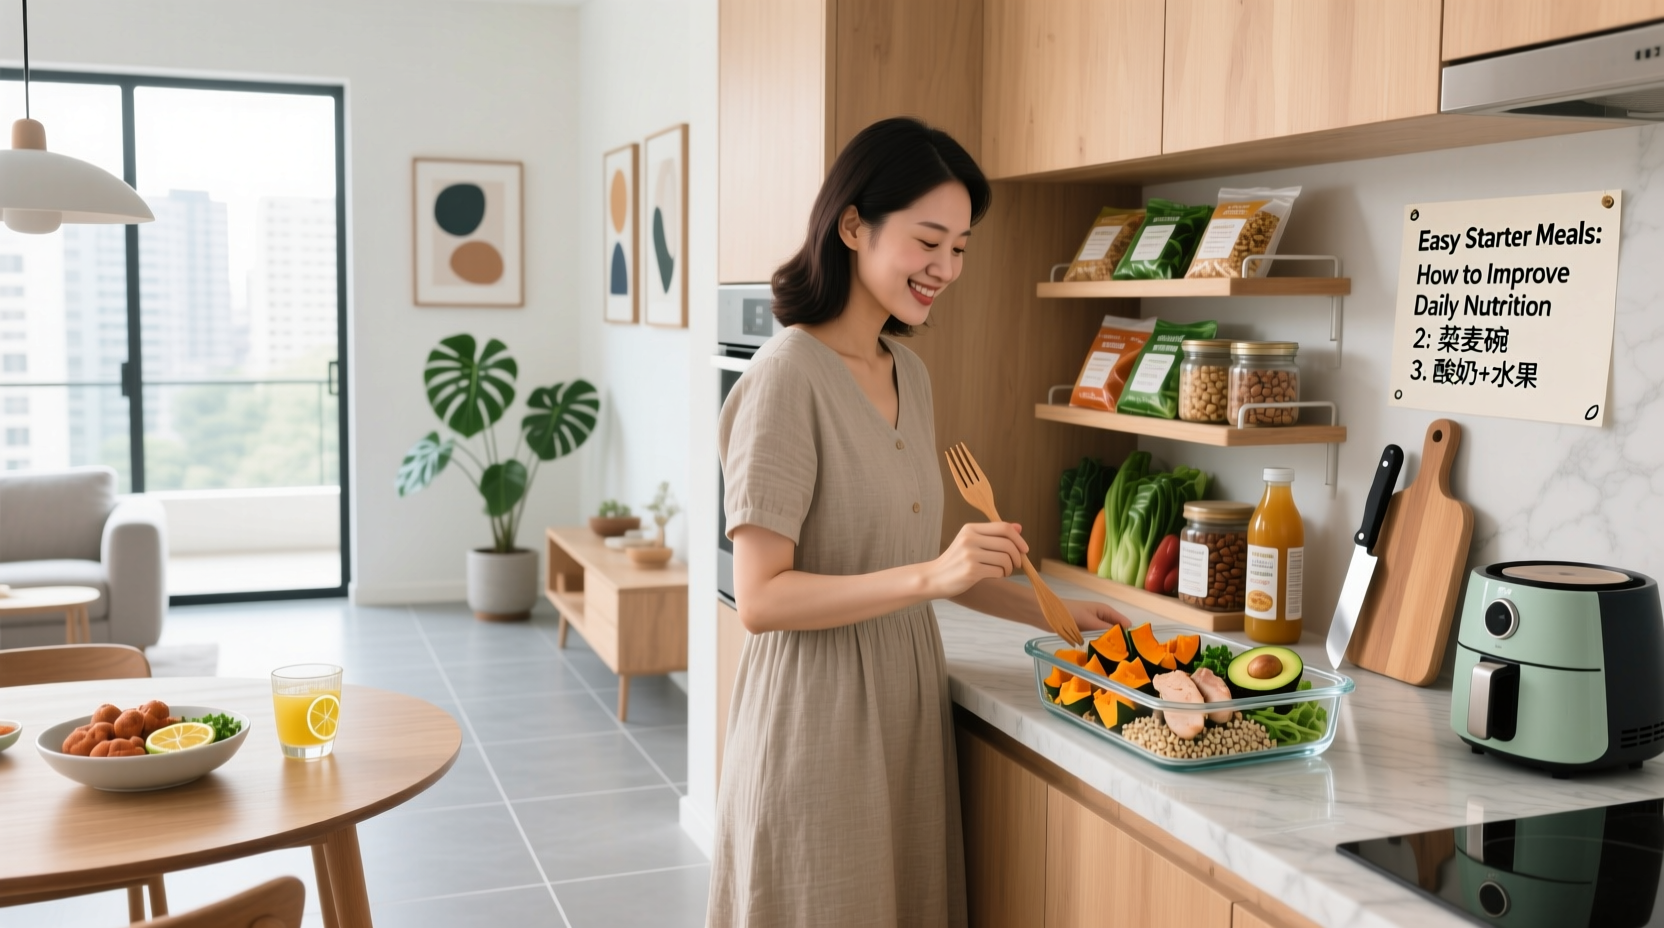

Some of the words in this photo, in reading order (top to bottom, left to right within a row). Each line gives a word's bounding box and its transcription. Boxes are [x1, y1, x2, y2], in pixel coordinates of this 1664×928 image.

[1419, 230, 1461, 255] Easy
[1466, 227, 1532, 248] Starter
[1536, 221, 1602, 245] Meals:
[1417, 264, 1459, 285] How
[1463, 265, 1482, 284] to
[1487, 263, 1569, 290] Improve
[1414, 293, 1459, 321] Daily
[1464, 294, 1551, 316] Nutrition
[1413, 327, 1431, 348] 2:
[1410, 360, 1426, 381] 3.
